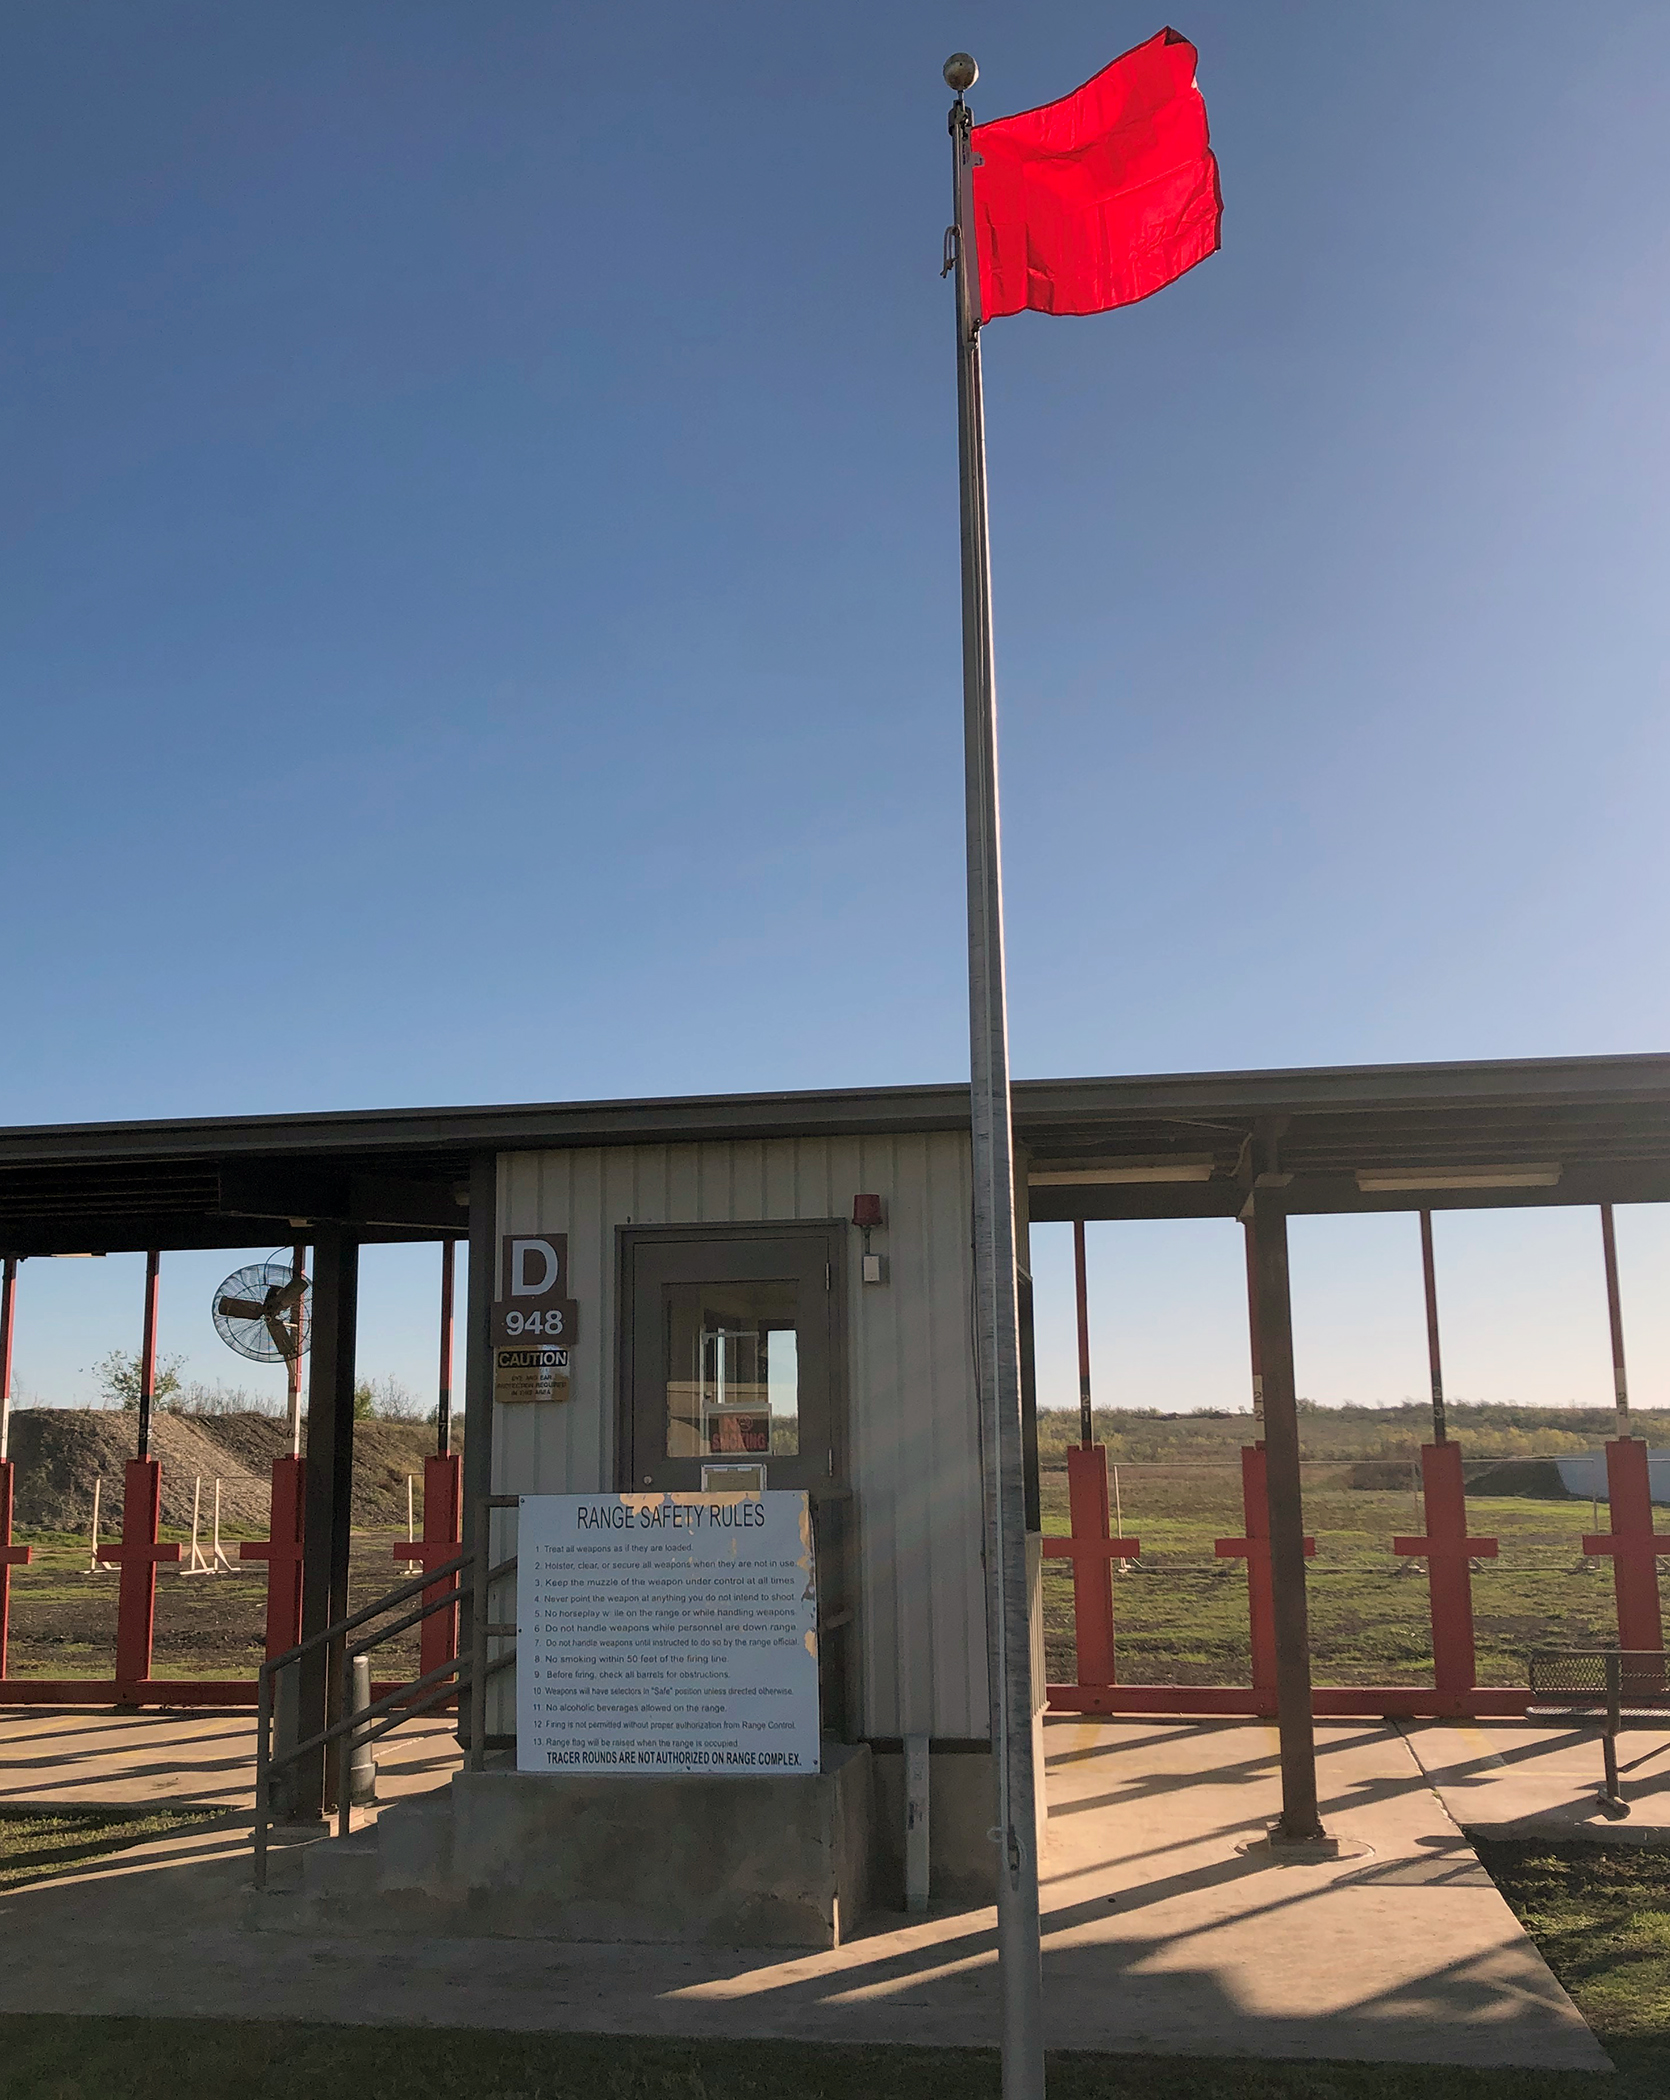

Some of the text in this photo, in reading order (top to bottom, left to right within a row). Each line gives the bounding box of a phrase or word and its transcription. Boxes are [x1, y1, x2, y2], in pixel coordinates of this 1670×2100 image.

[512, 1239, 559, 1296] D
[505, 1310, 564, 1336] 948
[499, 1351, 568, 1367] CAUTION
[577, 1503, 765, 1529] RANGE SAFETY RULES
[543, 1545, 565, 1553] Treat
[631, 1545, 649, 1553] they
[653, 1562, 691, 1570] weapons
[717, 1560, 737, 1569] they
[545, 1579, 569, 1588] Keep
[620, 1578, 630, 1586] of
[647, 1579, 683, 1587] weapon
[713, 1577, 745, 1585] control
[544, 1595, 568, 1603] Never
[570, 1595, 591, 1604] point
[651, 1594, 686, 1604] anything
[688, 1595, 704, 1603] you
[733, 1593, 759, 1601] intend
[544, 1610, 558, 1618] No
[559, 1610, 600, 1618] horseplay
[654, 1610, 680, 1619] range
[716, 1608, 754, 1619] handling
[545, 1624, 559, 1632] Do
[576, 1624, 607, 1632] handle
[609, 1625, 650, 1633] weapons
[651, 1623, 676, 1632] while
[677, 1623, 723, 1632] personnel
[742, 1623, 768, 1631] down
[545, 1639, 558, 1647] Do
[571, 1639, 598, 1647] handle
[599, 1640, 634, 1648] weapons
[723, 1639, 734, 1647] by
[748, 1640, 772, 1648] range
[545, 1655, 558, 1663] No
[560, 1655, 597, 1665] smoking
[598, 1655, 625, 1663] within
[626, 1655, 639, 1663] 50
[640, 1654, 658, 1663] feet
[659, 1655, 669, 1663] of
[670, 1655, 685, 1663] the
[686, 1655, 709, 1665] firing
[636, 1671, 665, 1679] barrels
[544, 1687, 577, 1696] Weapons
[579, 1687, 591, 1695] will
[703, 1687, 727, 1695] unless
[728, 1687, 757, 1695] directed
[559, 1703, 595, 1712] alcoholic
[596, 1704, 639, 1713] beverages
[640, 1704, 672, 1712] allowed
[723, 1721, 740, 1729] from
[741, 1721, 766, 1731] Range
[545, 1738, 571, 1748] Range
[571, 1738, 586, 1748] flag
[586, 1738, 600, 1746] will
[600, 1738, 611, 1747] be
[636, 1739, 658, 1747] when
[658, 1739, 671, 1747] the
[671, 1740, 695, 1749] range
[546, 1750, 802, 1766] TRACER ROUNDS ARE NOT AUTHORIZED ON RANGE COMPLEX.
